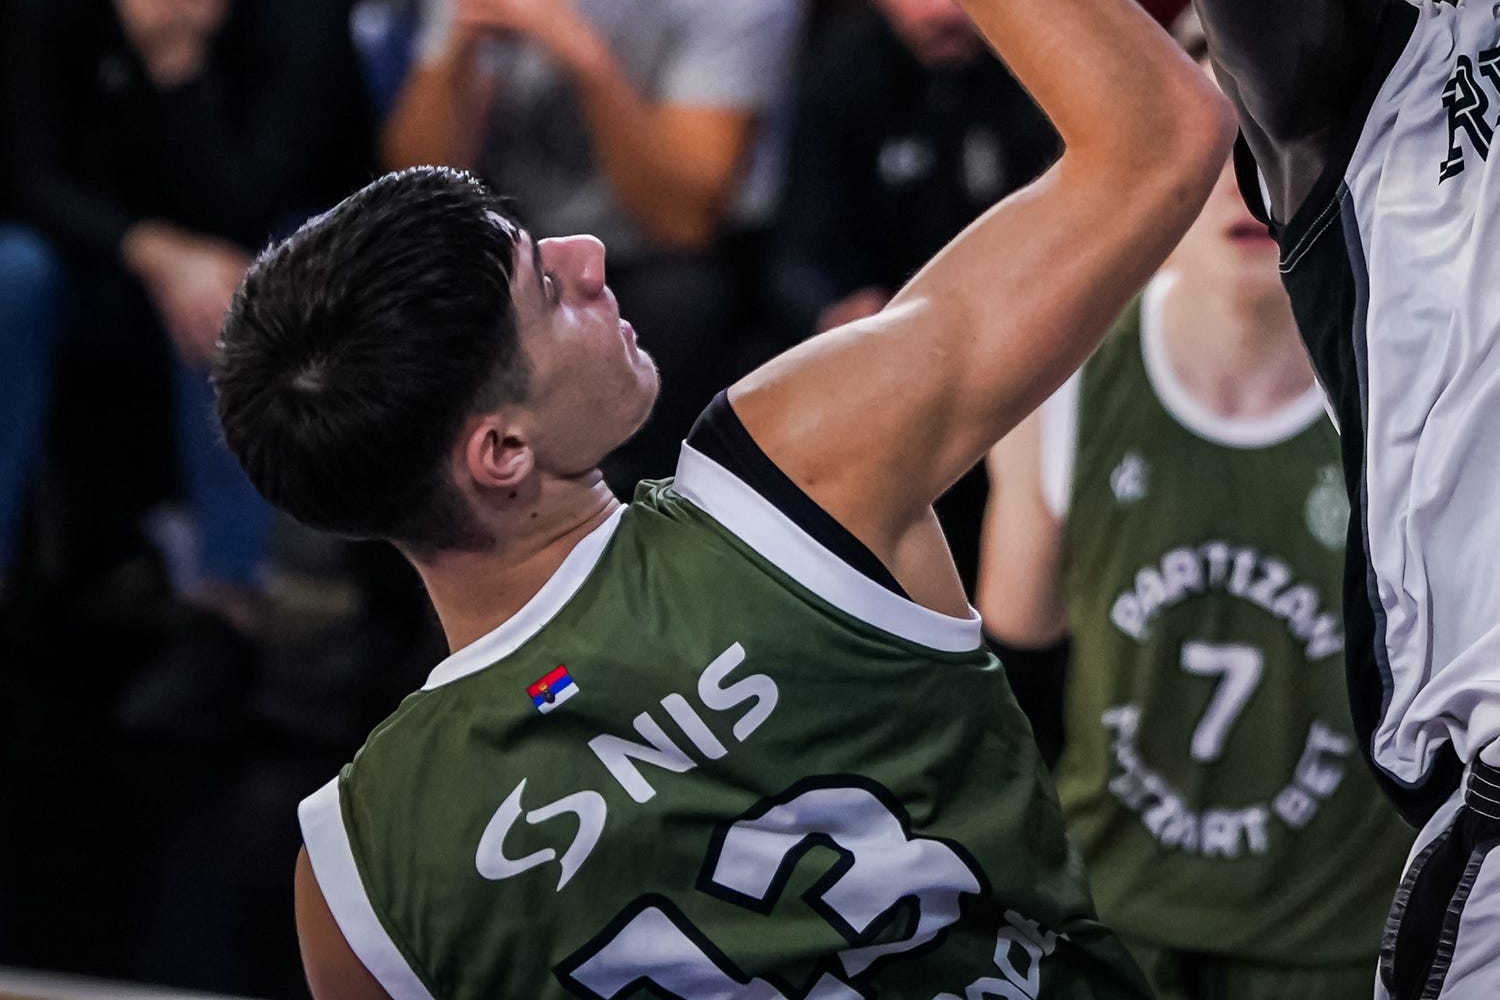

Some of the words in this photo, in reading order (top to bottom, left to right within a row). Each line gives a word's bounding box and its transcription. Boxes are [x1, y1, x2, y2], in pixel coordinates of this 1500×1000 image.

[1110, 542, 1346, 660] PARTIZAN
[587, 641, 779, 804] NIS
[1180, 640, 1264, 763] 7
[1272, 720, 1350, 827] BET
